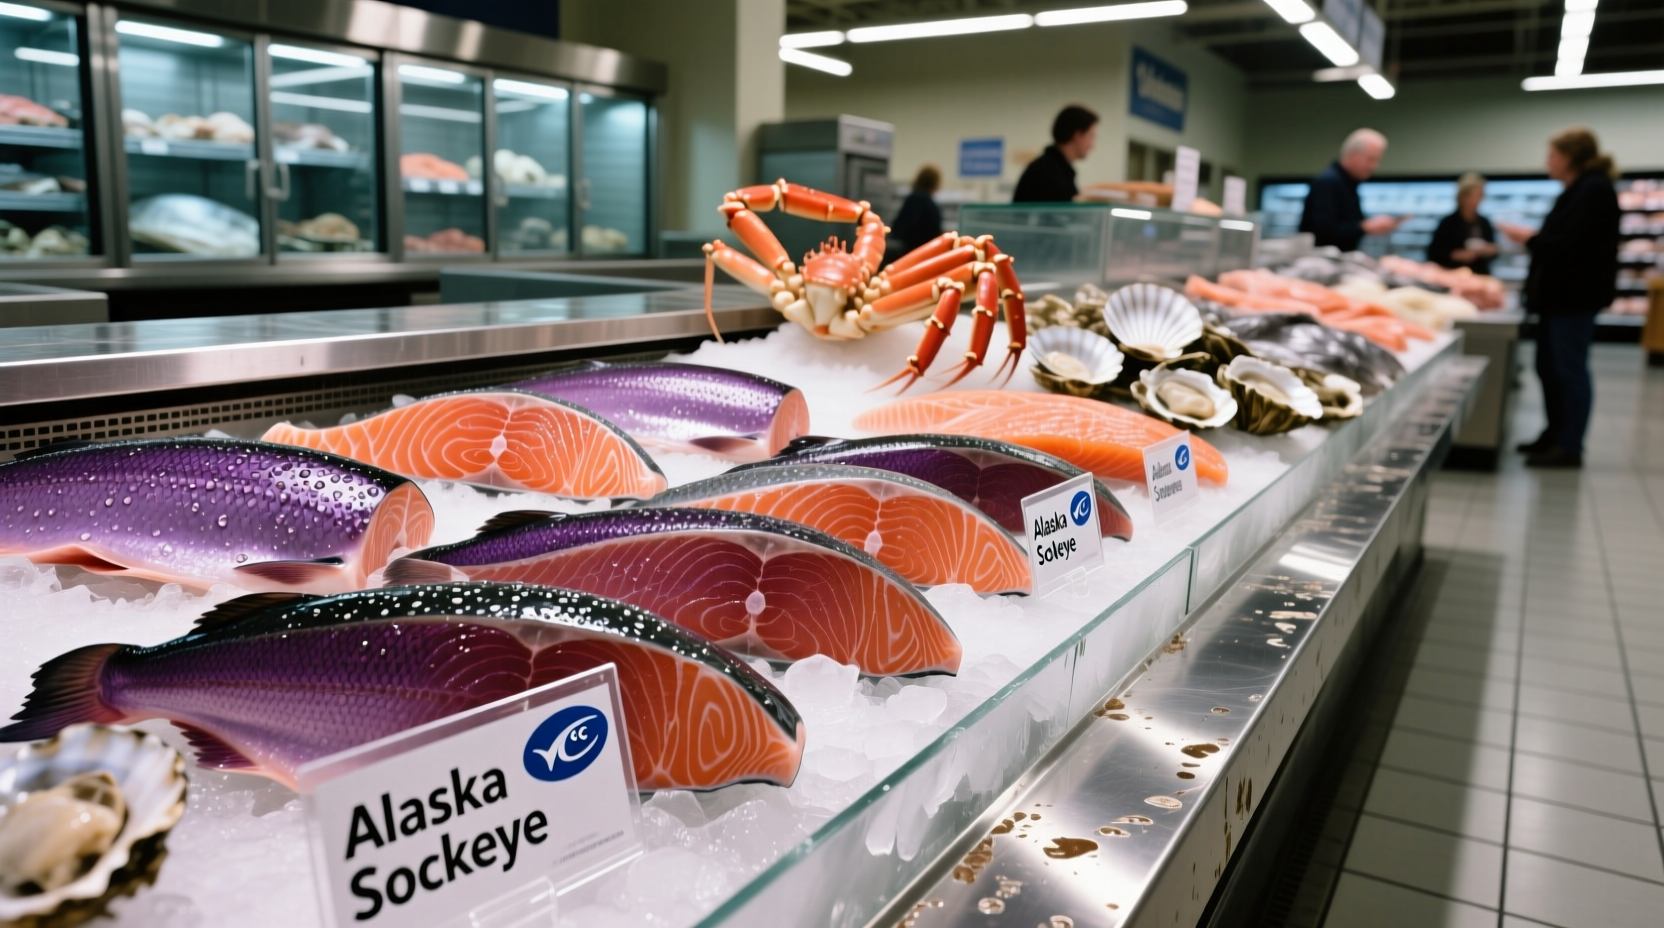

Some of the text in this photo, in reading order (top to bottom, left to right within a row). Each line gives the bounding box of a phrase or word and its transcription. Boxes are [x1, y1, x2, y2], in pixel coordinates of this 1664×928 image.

[1034, 512, 1067, 541] Alaska
[345, 768, 508, 860] Alaska
[350, 809, 548, 921] Sockeye
